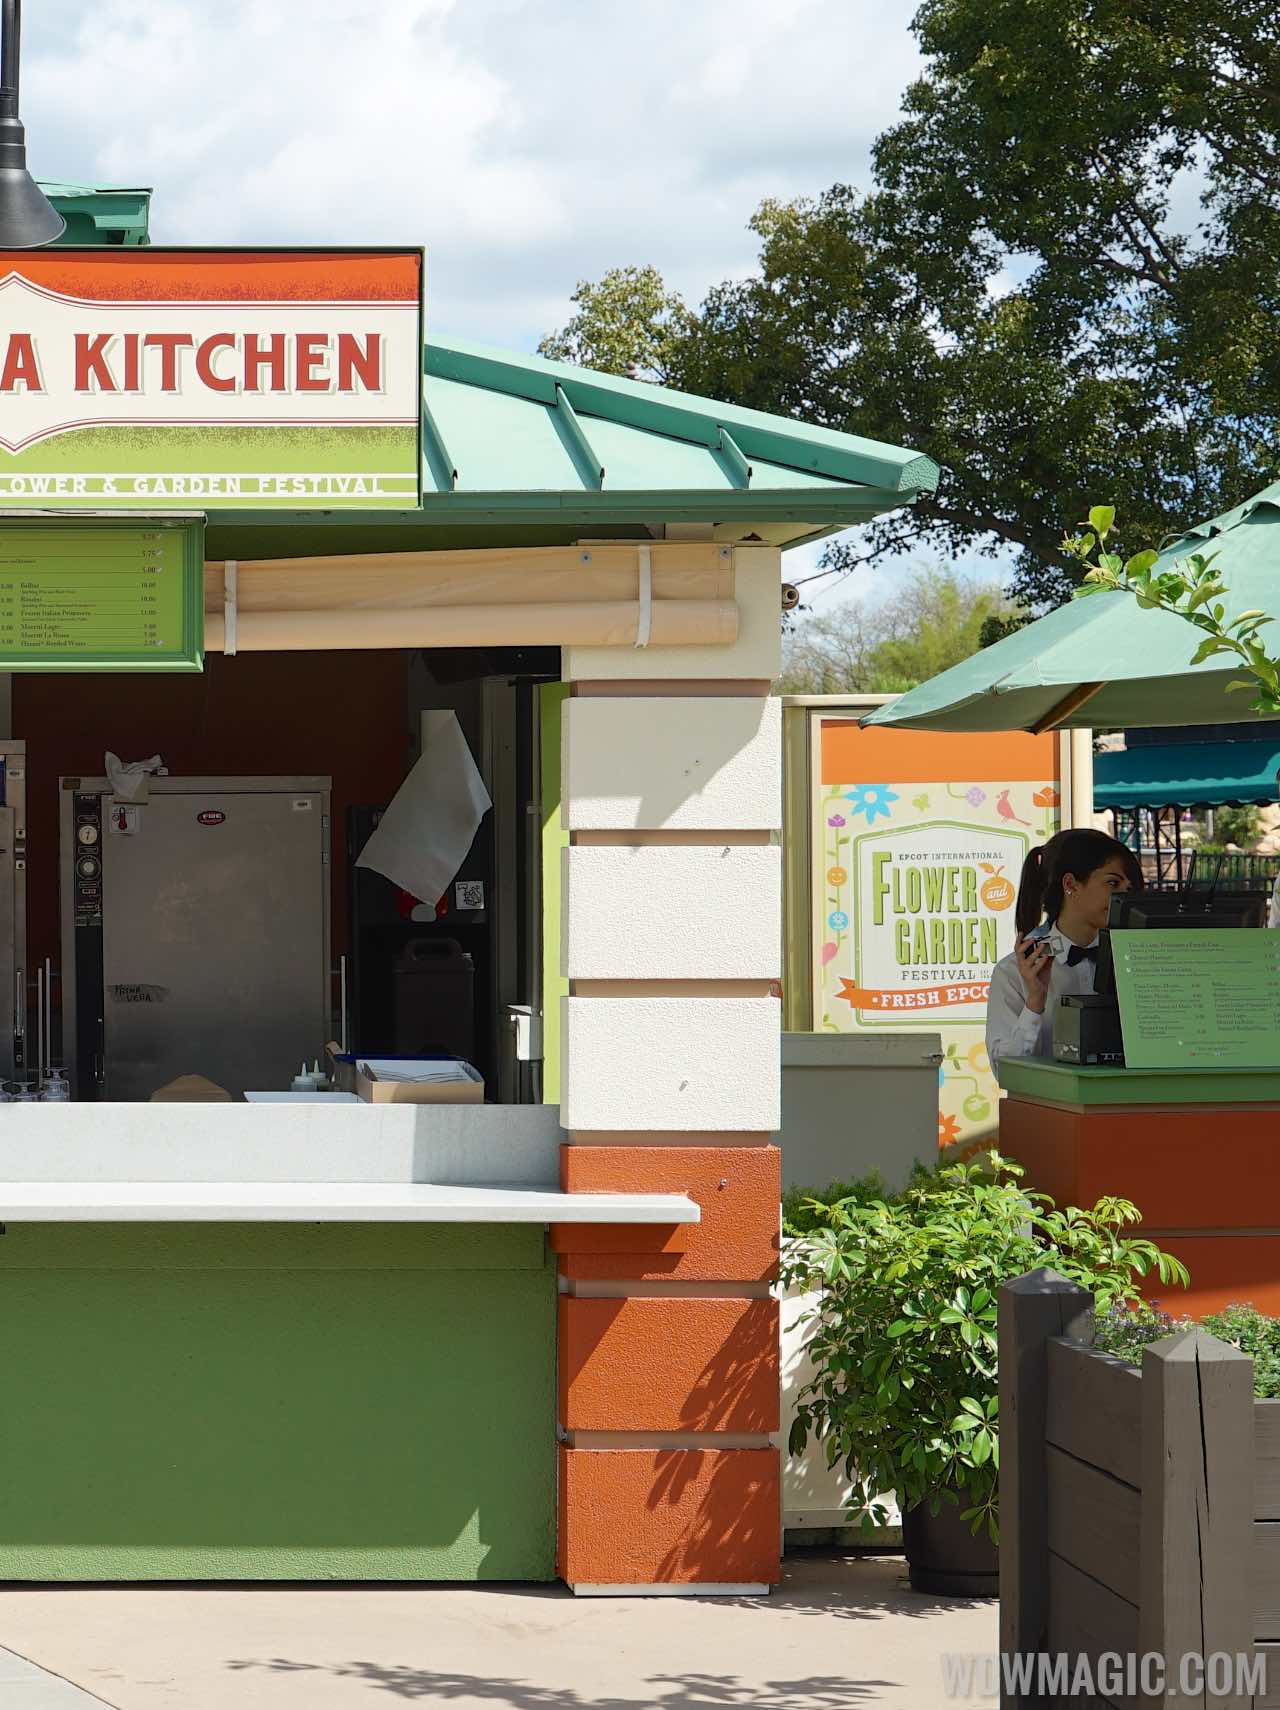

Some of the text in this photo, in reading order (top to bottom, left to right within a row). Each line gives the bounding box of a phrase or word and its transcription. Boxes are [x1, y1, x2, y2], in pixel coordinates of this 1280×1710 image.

[73, 332, 384, 393] KITCHEN
[103, 477, 122, 494] &
[133, 477, 241, 494] GARDEN
[258, 477, 385, 494] FESTIVAL
[898, 852, 1004, 861] EPCOT INTERNATIONAL
[872, 851, 1008, 926] FLOWER and
[894, 917, 999, 966] GARDEN
[901, 969, 976, 981] FESTIVAL
[880, 990, 940, 1008] FRESH
